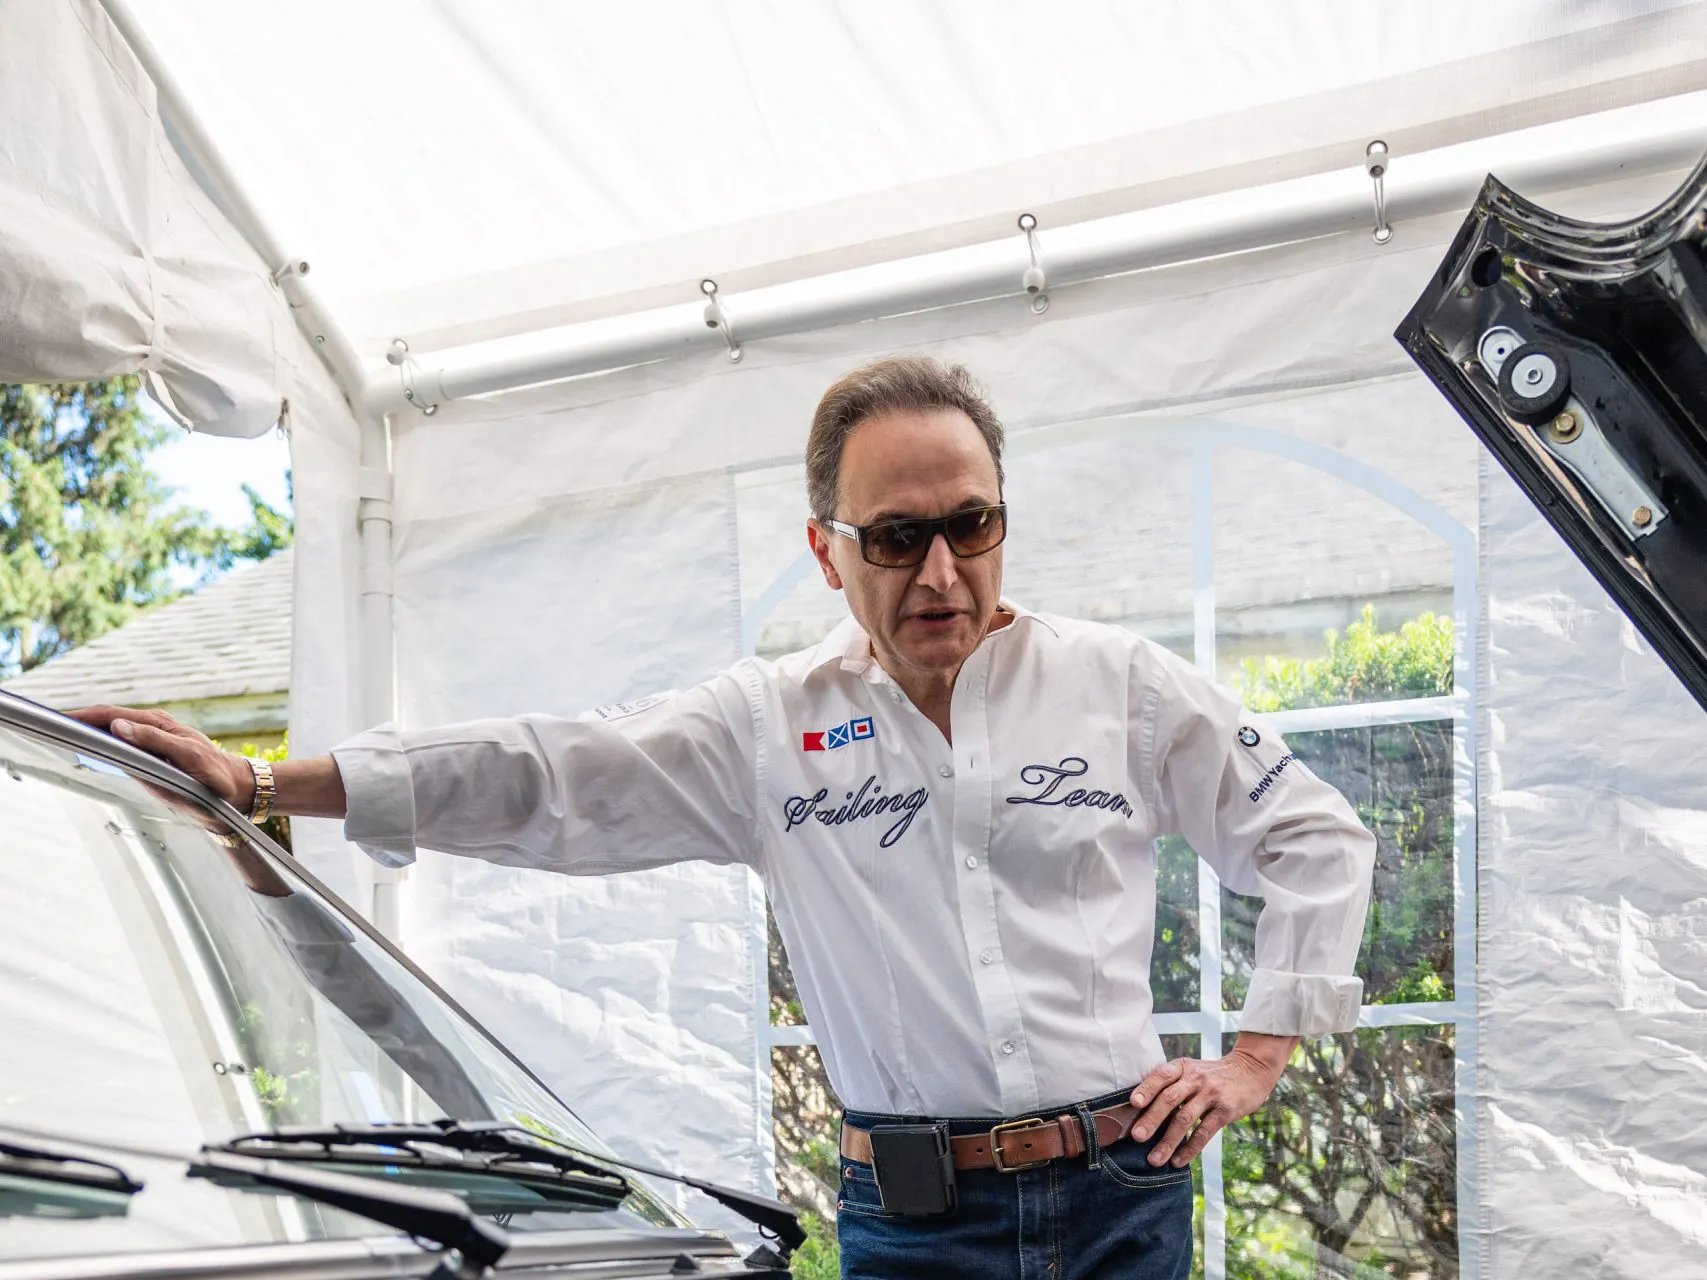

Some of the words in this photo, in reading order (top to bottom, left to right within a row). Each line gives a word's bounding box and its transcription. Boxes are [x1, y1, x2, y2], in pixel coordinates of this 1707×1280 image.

[1249, 774, 1274, 802] BMW
[1268, 753, 1297, 777] Yach
[784, 775, 929, 848] Sailing
